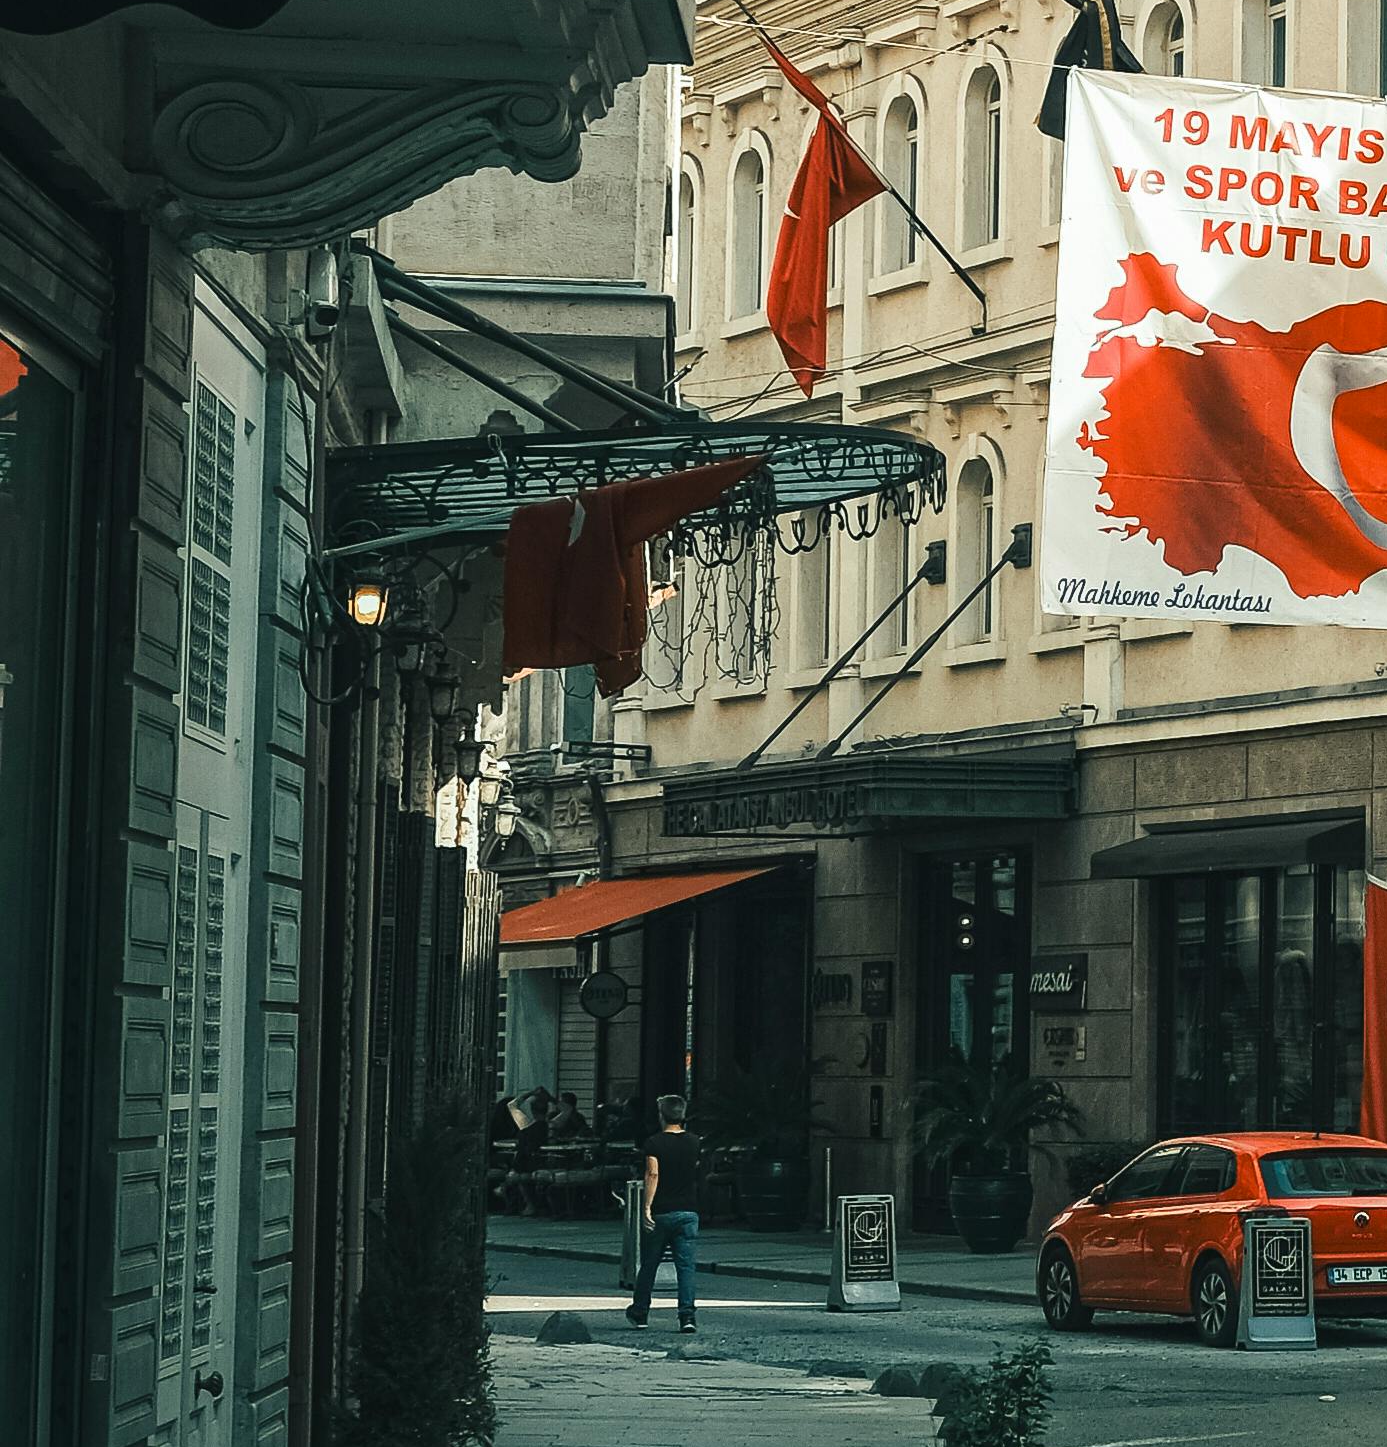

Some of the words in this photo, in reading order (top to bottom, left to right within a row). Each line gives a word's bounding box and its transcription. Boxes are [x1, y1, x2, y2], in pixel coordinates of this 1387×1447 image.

[1153, 107, 1210, 146] 19
[1228, 114, 1385, 164] MAYIS
[1111, 164, 1166, 195] ve
[1183, 163, 1321, 213] SPOR
[1200, 217, 1372, 270] KUTLU
[1057, 577, 1160, 608] Mahkeme
[1164, 582, 1273, 613] Lokantası
[1030, 964, 1073, 993] mesai
[1334, 1268, 1348, 1281] 34
